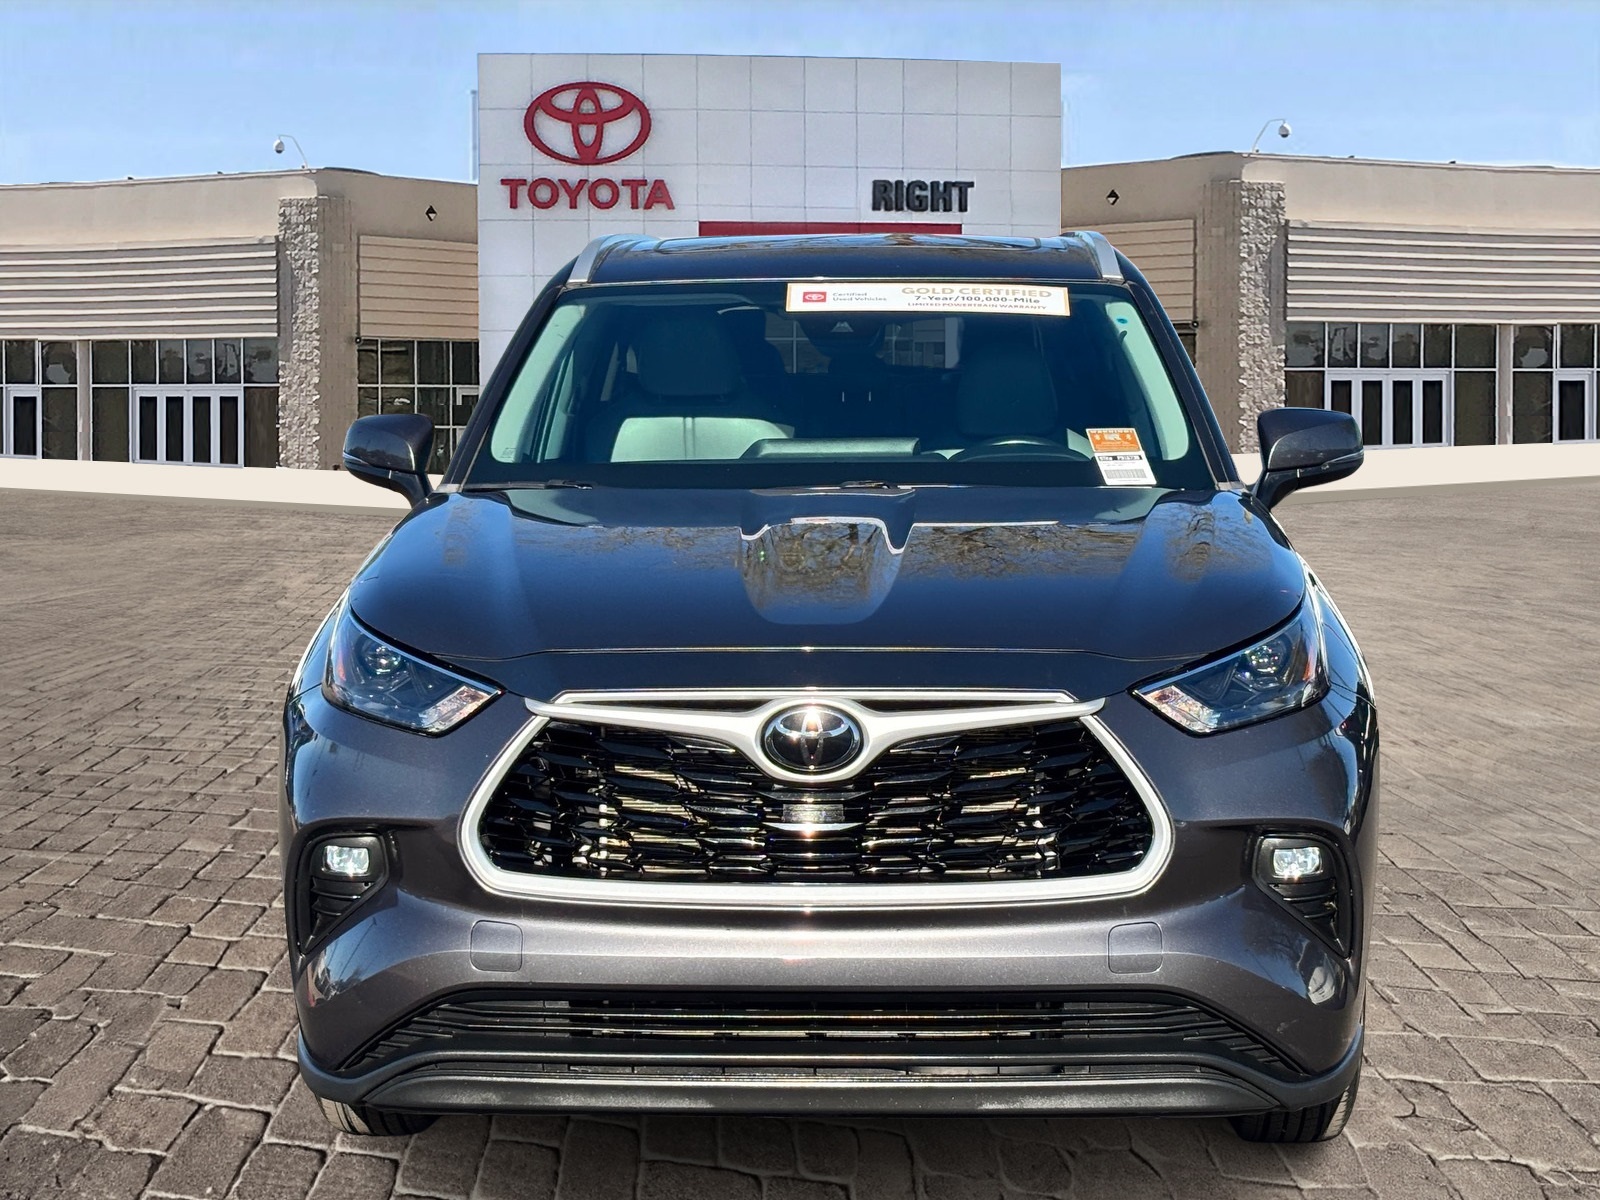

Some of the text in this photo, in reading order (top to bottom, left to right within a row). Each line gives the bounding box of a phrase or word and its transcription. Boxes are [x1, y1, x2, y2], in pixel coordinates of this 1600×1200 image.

[500, 178, 675, 210] TOYOTA
[872, 179, 974, 212] RIGHT
[901, 287, 1052, 298] GOLD CERTIFIED
[914, 295, 1041, 304] 7-Year/100,000-Mile
